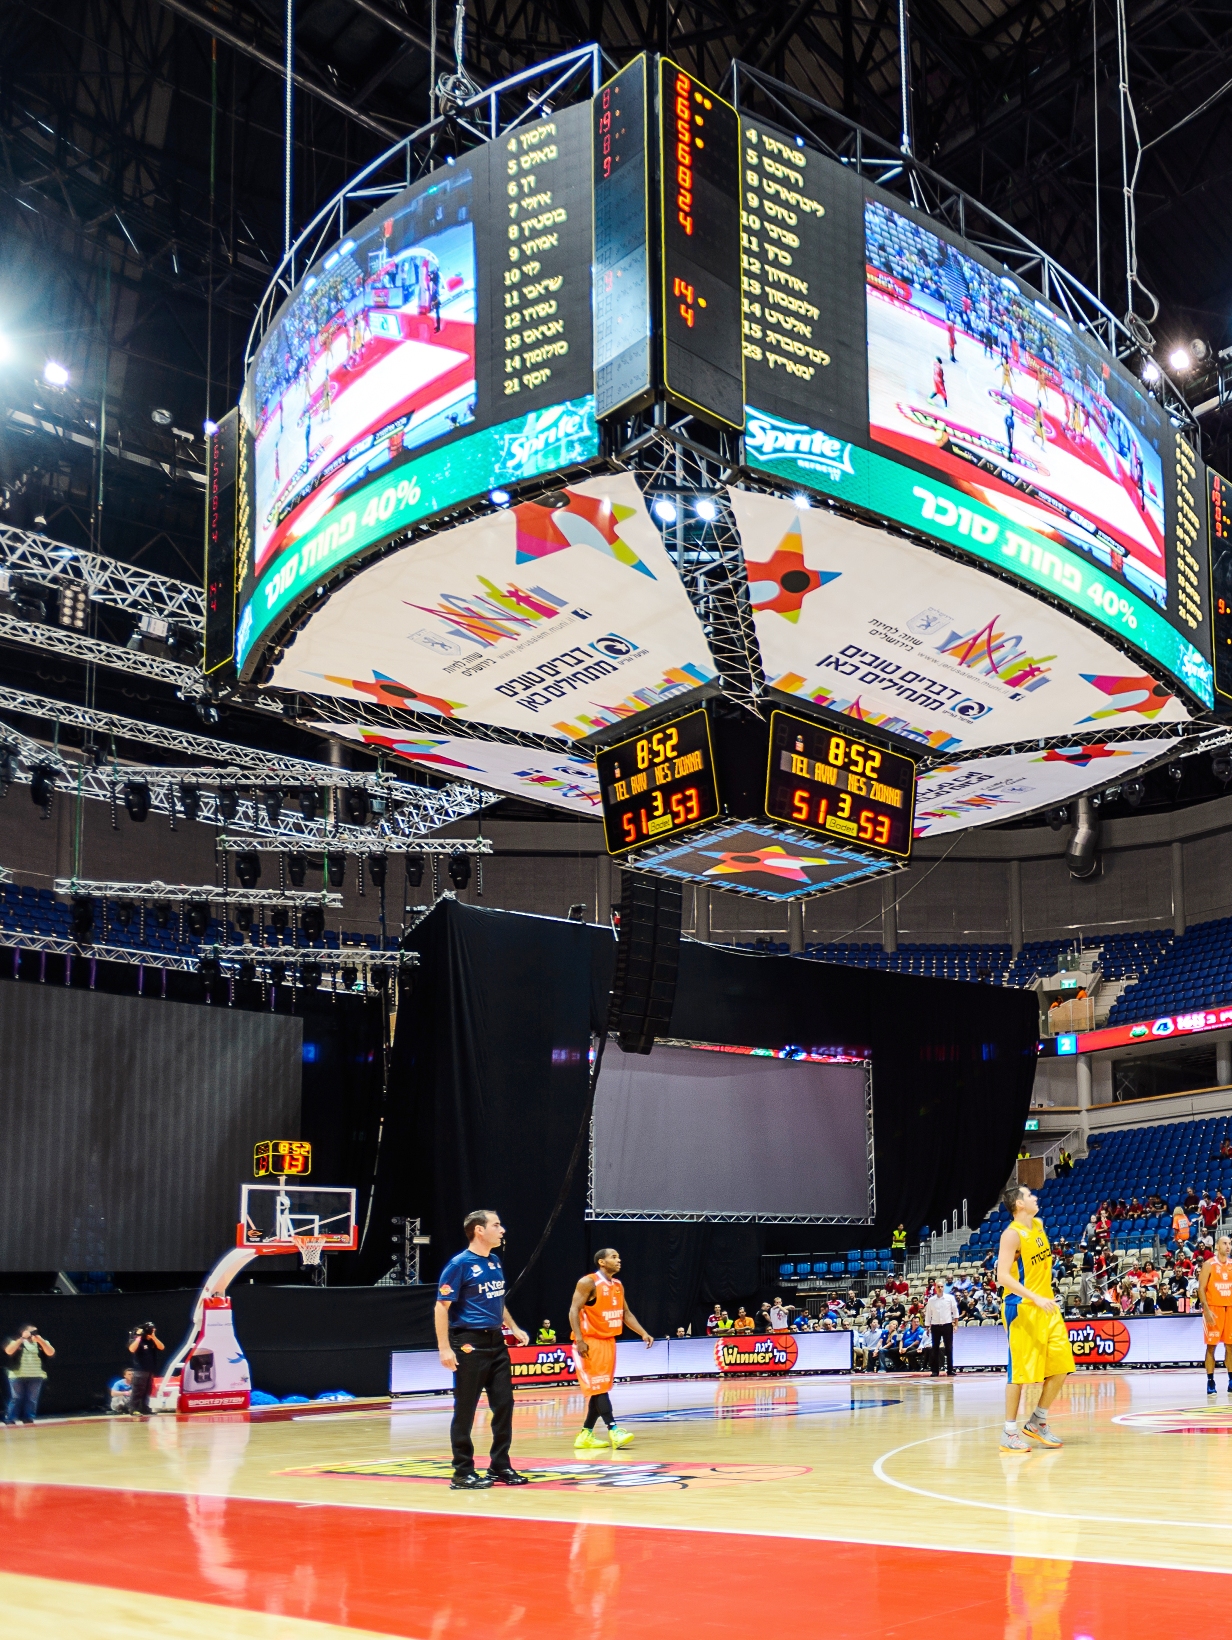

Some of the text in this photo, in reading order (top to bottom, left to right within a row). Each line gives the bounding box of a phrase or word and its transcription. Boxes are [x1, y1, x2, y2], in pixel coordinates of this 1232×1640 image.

[676, 72, 691, 98] 2
[676, 96, 691, 122] 6
[507, 123, 557, 153] 4 וילסון
[677, 118, 691, 145] 5
[677, 141, 692, 166] 6
[746, 128, 806, 167] 4 פארגו
[507, 159, 518, 176] 5
[603, 156, 612, 179] 9
[677, 165, 692, 189] 8
[746, 148, 804, 188] 5 היינס
[746, 169, 759, 187] 8
[507, 180, 519, 197] 6
[677, 188, 692, 212] 2
[508, 202, 519, 219] 7
[746, 192, 797, 226] 9 טיוס
[508, 224, 520, 240] 8
[679, 211, 693, 236] 4
[741, 210, 800, 248] 10 פניני
[508, 246, 520, 262] 9
[741, 232, 759, 252] 11
[504, 260, 541, 286] 10 לוי
[741, 254, 761, 274] 12
[673, 277, 694, 305] 14
[741, 276, 761, 295] 13
[504, 290, 520, 308] 11
[741, 298, 762, 318] 14
[504, 311, 521, 330] 12
[680, 303, 694, 328] 4
[504, 333, 522, 351] 13
[741, 320, 830, 366] 15 לנדסברג
[742, 341, 763, 361] 23
[504, 340, 569, 373] 14 סולומון
[503, 368, 551, 395] 21 יוסף
[508, 403, 582, 468] Sprite
[746, 418, 842, 457] Sprite
[361, 475, 422, 530] 40%
[912, 485, 999, 545] סוכר
[300, 511, 356, 575] פחות
[1002, 530, 1083, 593] פחות
[1087, 580, 1138, 630] 40%
[868, 618, 923, 646] שווה לחיות
[868, 629, 914, 652] בירושלים
[461, 658, 497, 677] בירושלים
[463, 652, 483, 666] שווה
[494, 646, 594, 698] דברים טובים
[815, 654, 945, 712] מתחילים כאן
[838, 644, 962, 700] דברים טובים
[516, 659, 619, 713] מתחילים כאן
[636, 727, 679, 770] 8:52
[828, 736, 882, 779] 8:52
[655, 762, 672, 786] NES
[791, 753, 838, 787] TEL AVIV
[614, 781, 630, 801] TEL
[652, 790, 664, 817] 3
[848, 773, 867, 797] NES
[869, 780, 903, 809] ZIONNA
[671, 787, 700, 825] 53
[792, 790, 828, 825] 51
[837, 793, 852, 818] 3
[622, 808, 649, 843] 51
[650, 819, 671, 832] Bodet
[828, 818, 855, 834] Bodet
[858, 809, 891, 845] 53
[1061, 1038, 1071, 1051] 2
[278, 1142, 310, 1155] 8:52
[284, 1154, 304, 1172] 13
[1036, 1237, 1044, 1248] 10
[611, 1297, 617, 1306] 5
[755, 1338, 773, 1352] ליגת
[1069, 1325, 1095, 1342] ליגת
[1096, 1336, 1114, 1354] סל
[537, 1348, 565, 1363] ליגת
[723, 1347, 787, 1364] Winner סל
[188, 1396, 245, 1407] SPORTSYSTEM
